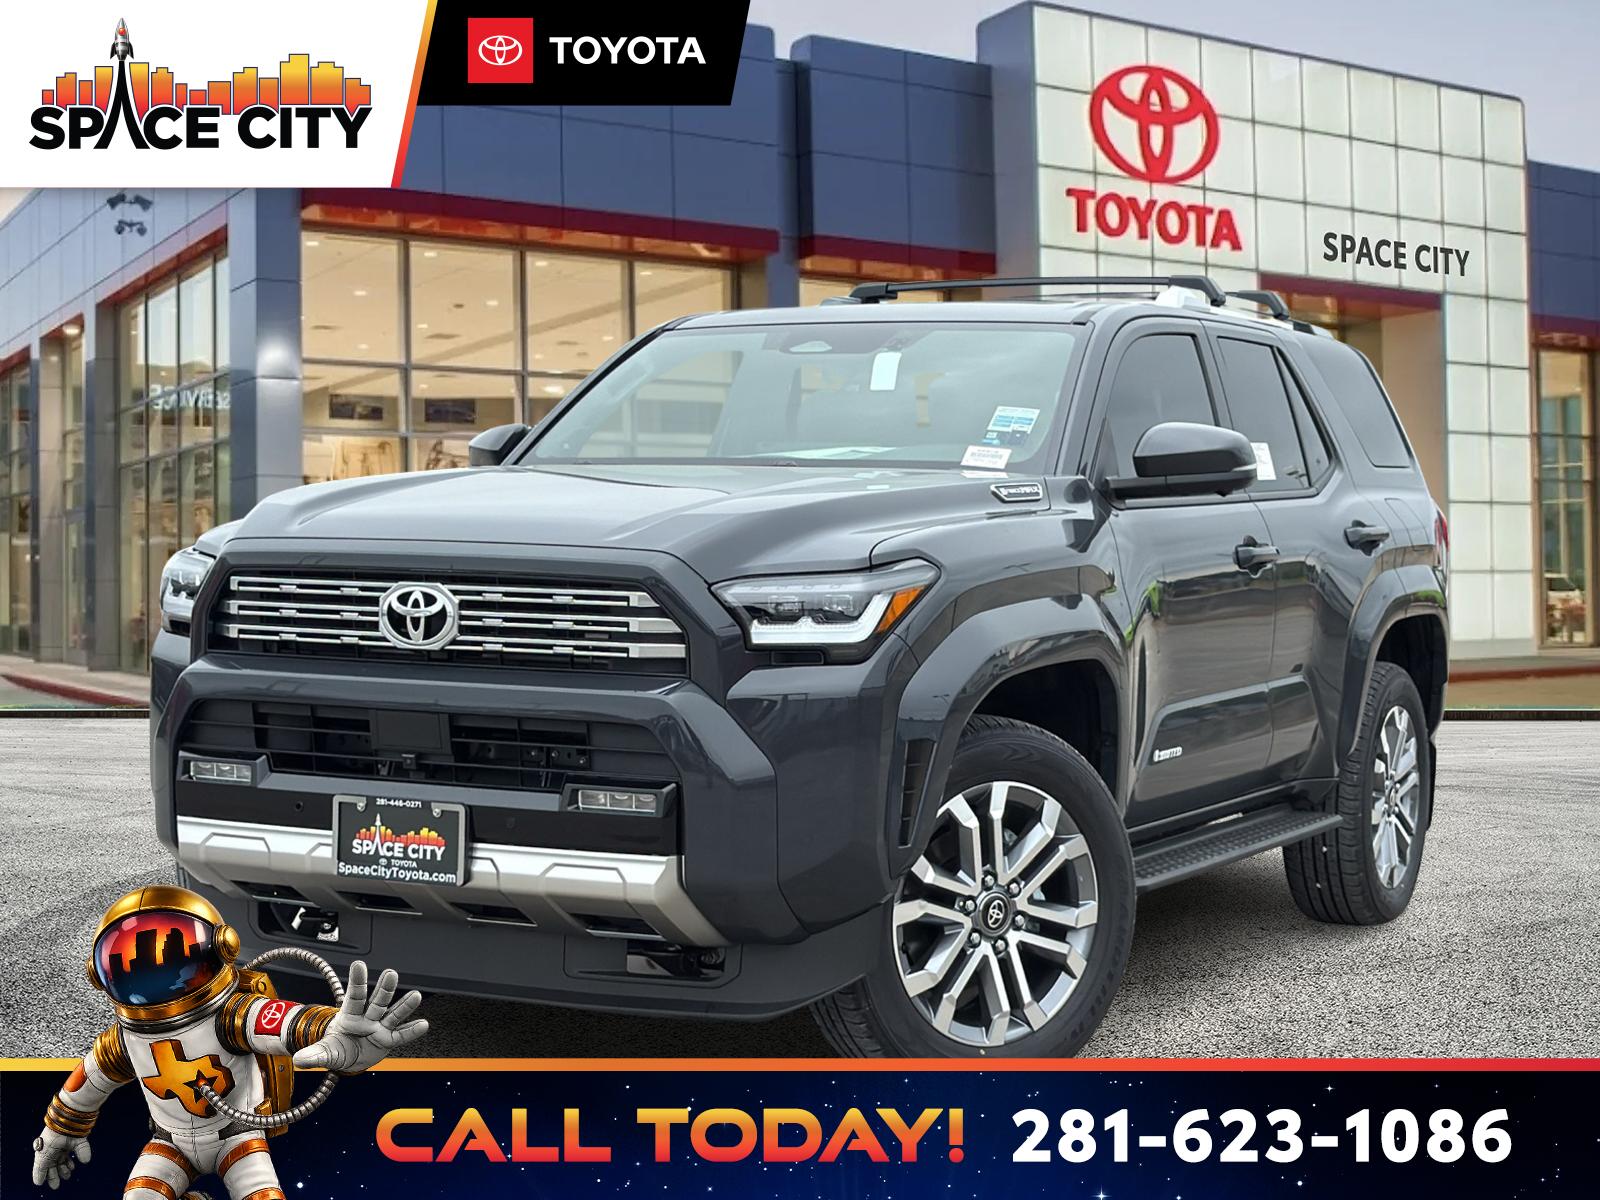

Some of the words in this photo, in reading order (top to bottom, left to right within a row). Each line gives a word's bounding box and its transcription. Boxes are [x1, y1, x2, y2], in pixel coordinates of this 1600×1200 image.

[1066, 187, 1242, 252] TOYOTA
[1323, 232, 1407, 269] SPACE
[1414, 245, 1470, 277] CITY
[352, 826, 404, 858] SPACE
[407, 843, 446, 861] CITY
[338, 862, 456, 883] SpaceCityToyota.com
[391, 859, 418, 868] TOYOTA
